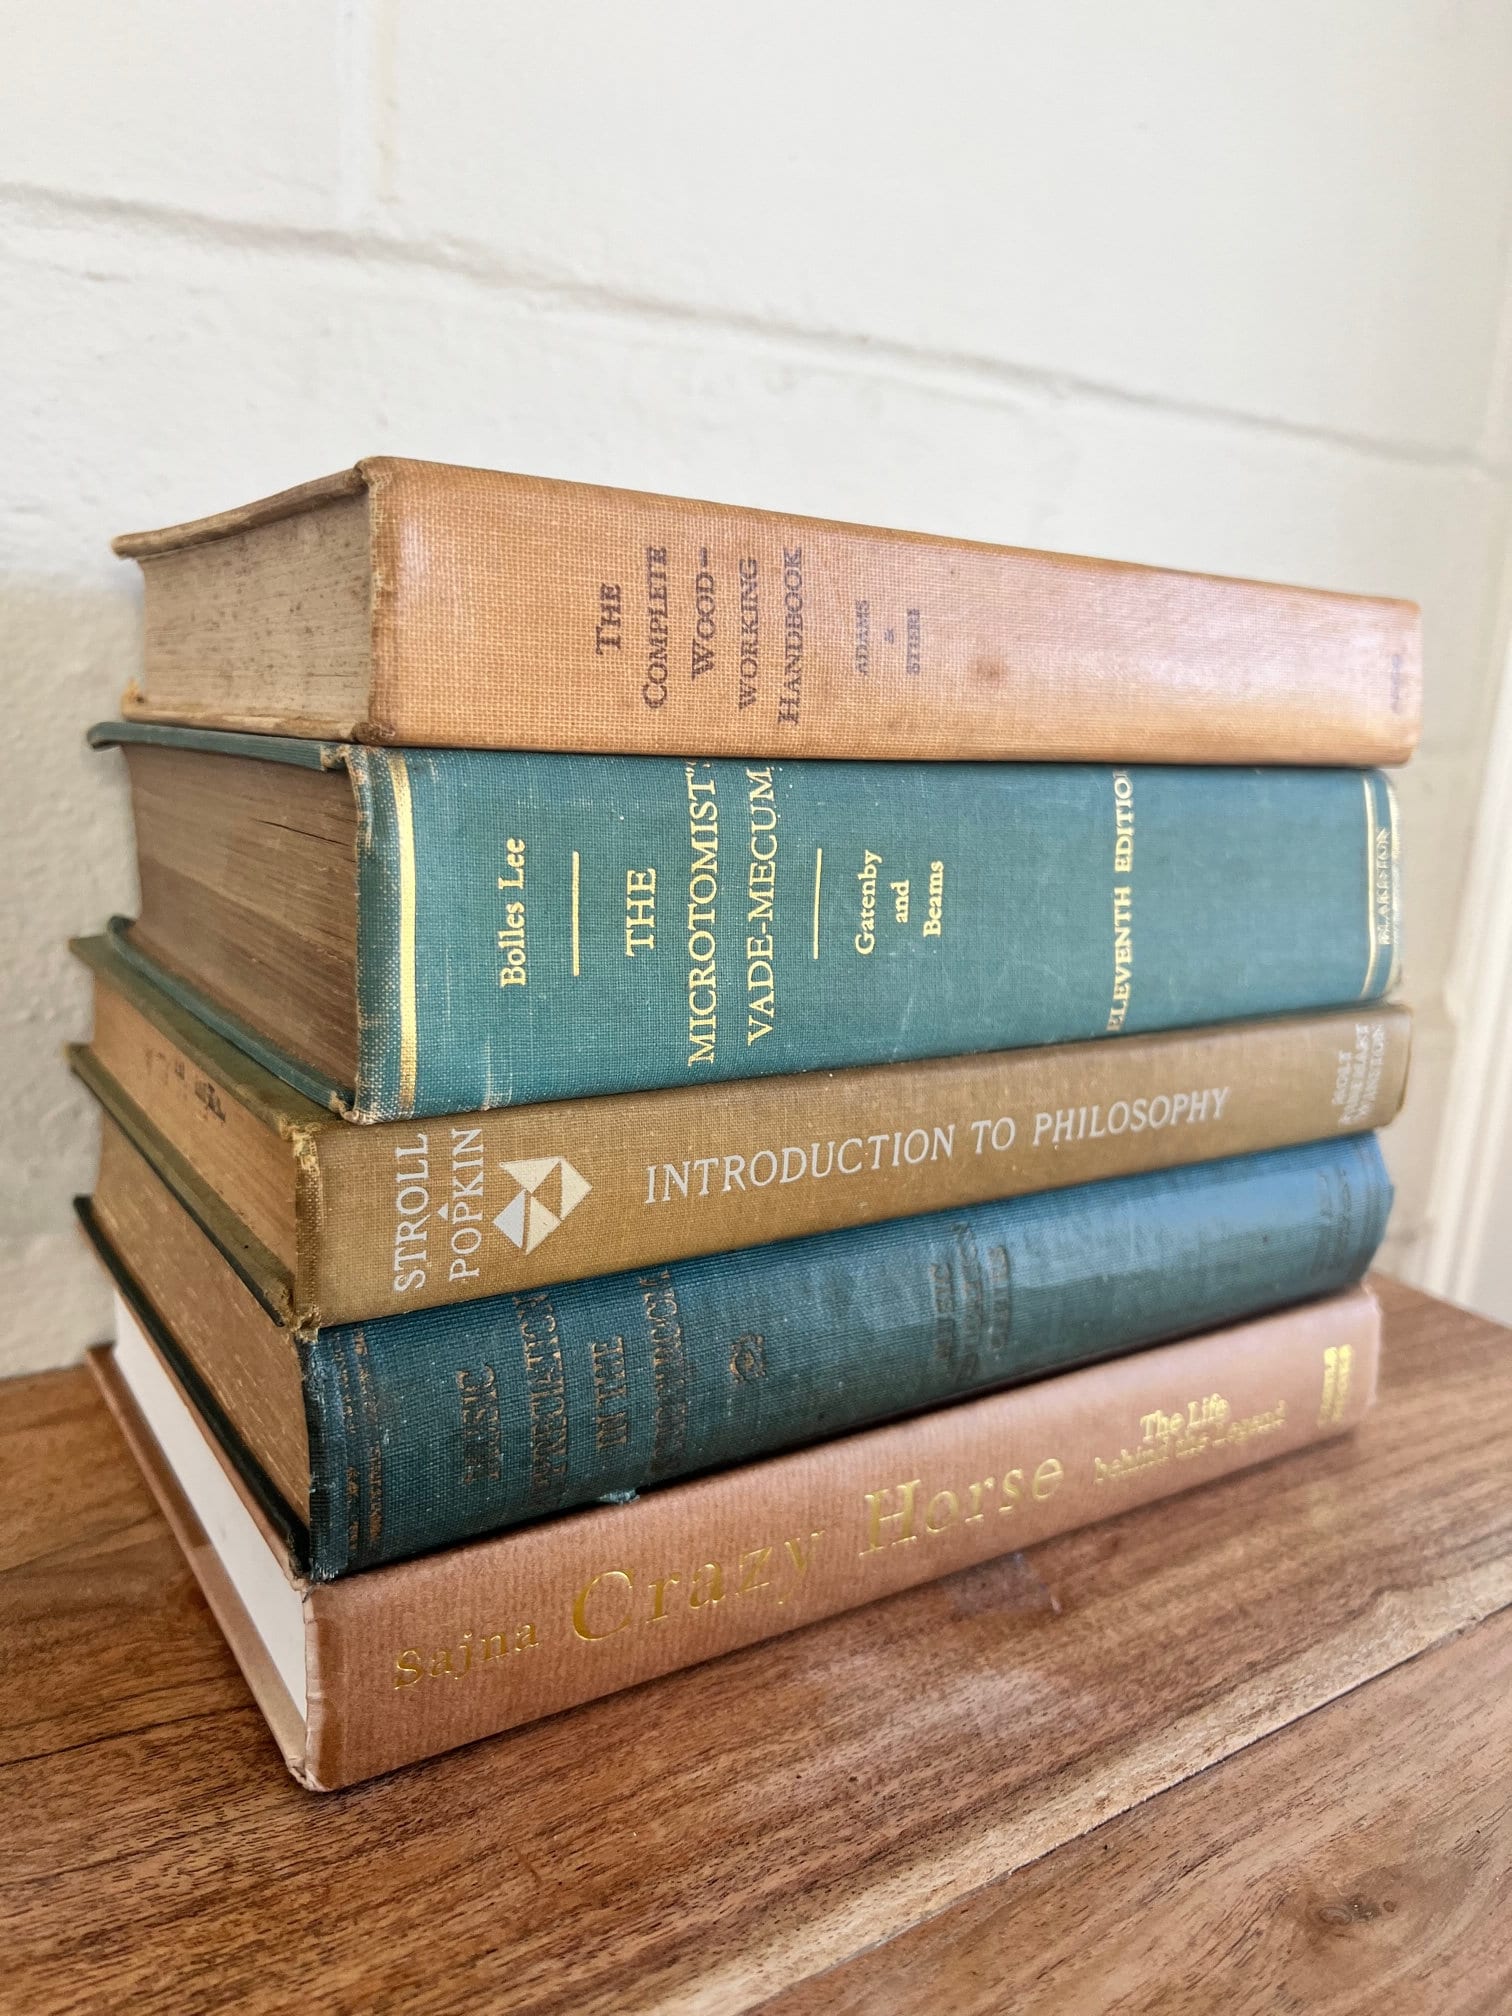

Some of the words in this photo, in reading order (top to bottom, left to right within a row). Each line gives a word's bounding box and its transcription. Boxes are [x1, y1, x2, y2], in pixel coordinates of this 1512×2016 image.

[596, 583, 621, 655] THE
[643, 546, 669, 709] COMPLETE
[739, 557, 759, 710] WORKING
[778, 547, 804, 725] HANDBOOK
[498, 837, 527, 891] Lee
[625, 867, 656, 957] THE
[747, 766, 778, 1047] VADE-MECUM
[855, 849, 883, 955] Gatenby
[890, 879, 911, 924] and
[923, 860, 945, 937] Beams
[498, 900, 527, 988] Bolles
[1106, 886, 1134, 1032] ELEVENTH
[449, 1127, 484, 1282] POPKIN
[644, 1121, 957, 1205] INTRODUCTION
[971, 1116, 1016, 1155] TO
[1033, 1086, 1231, 1148] PHILOSOPHY
[394, 1132, 429, 1293] STROLL
[1139, 1408, 1185, 1445] The
[394, 1621, 540, 1690] Sajna
[571, 1530, 825, 1642] Crazy
[860, 1457, 1065, 1559] Horse
